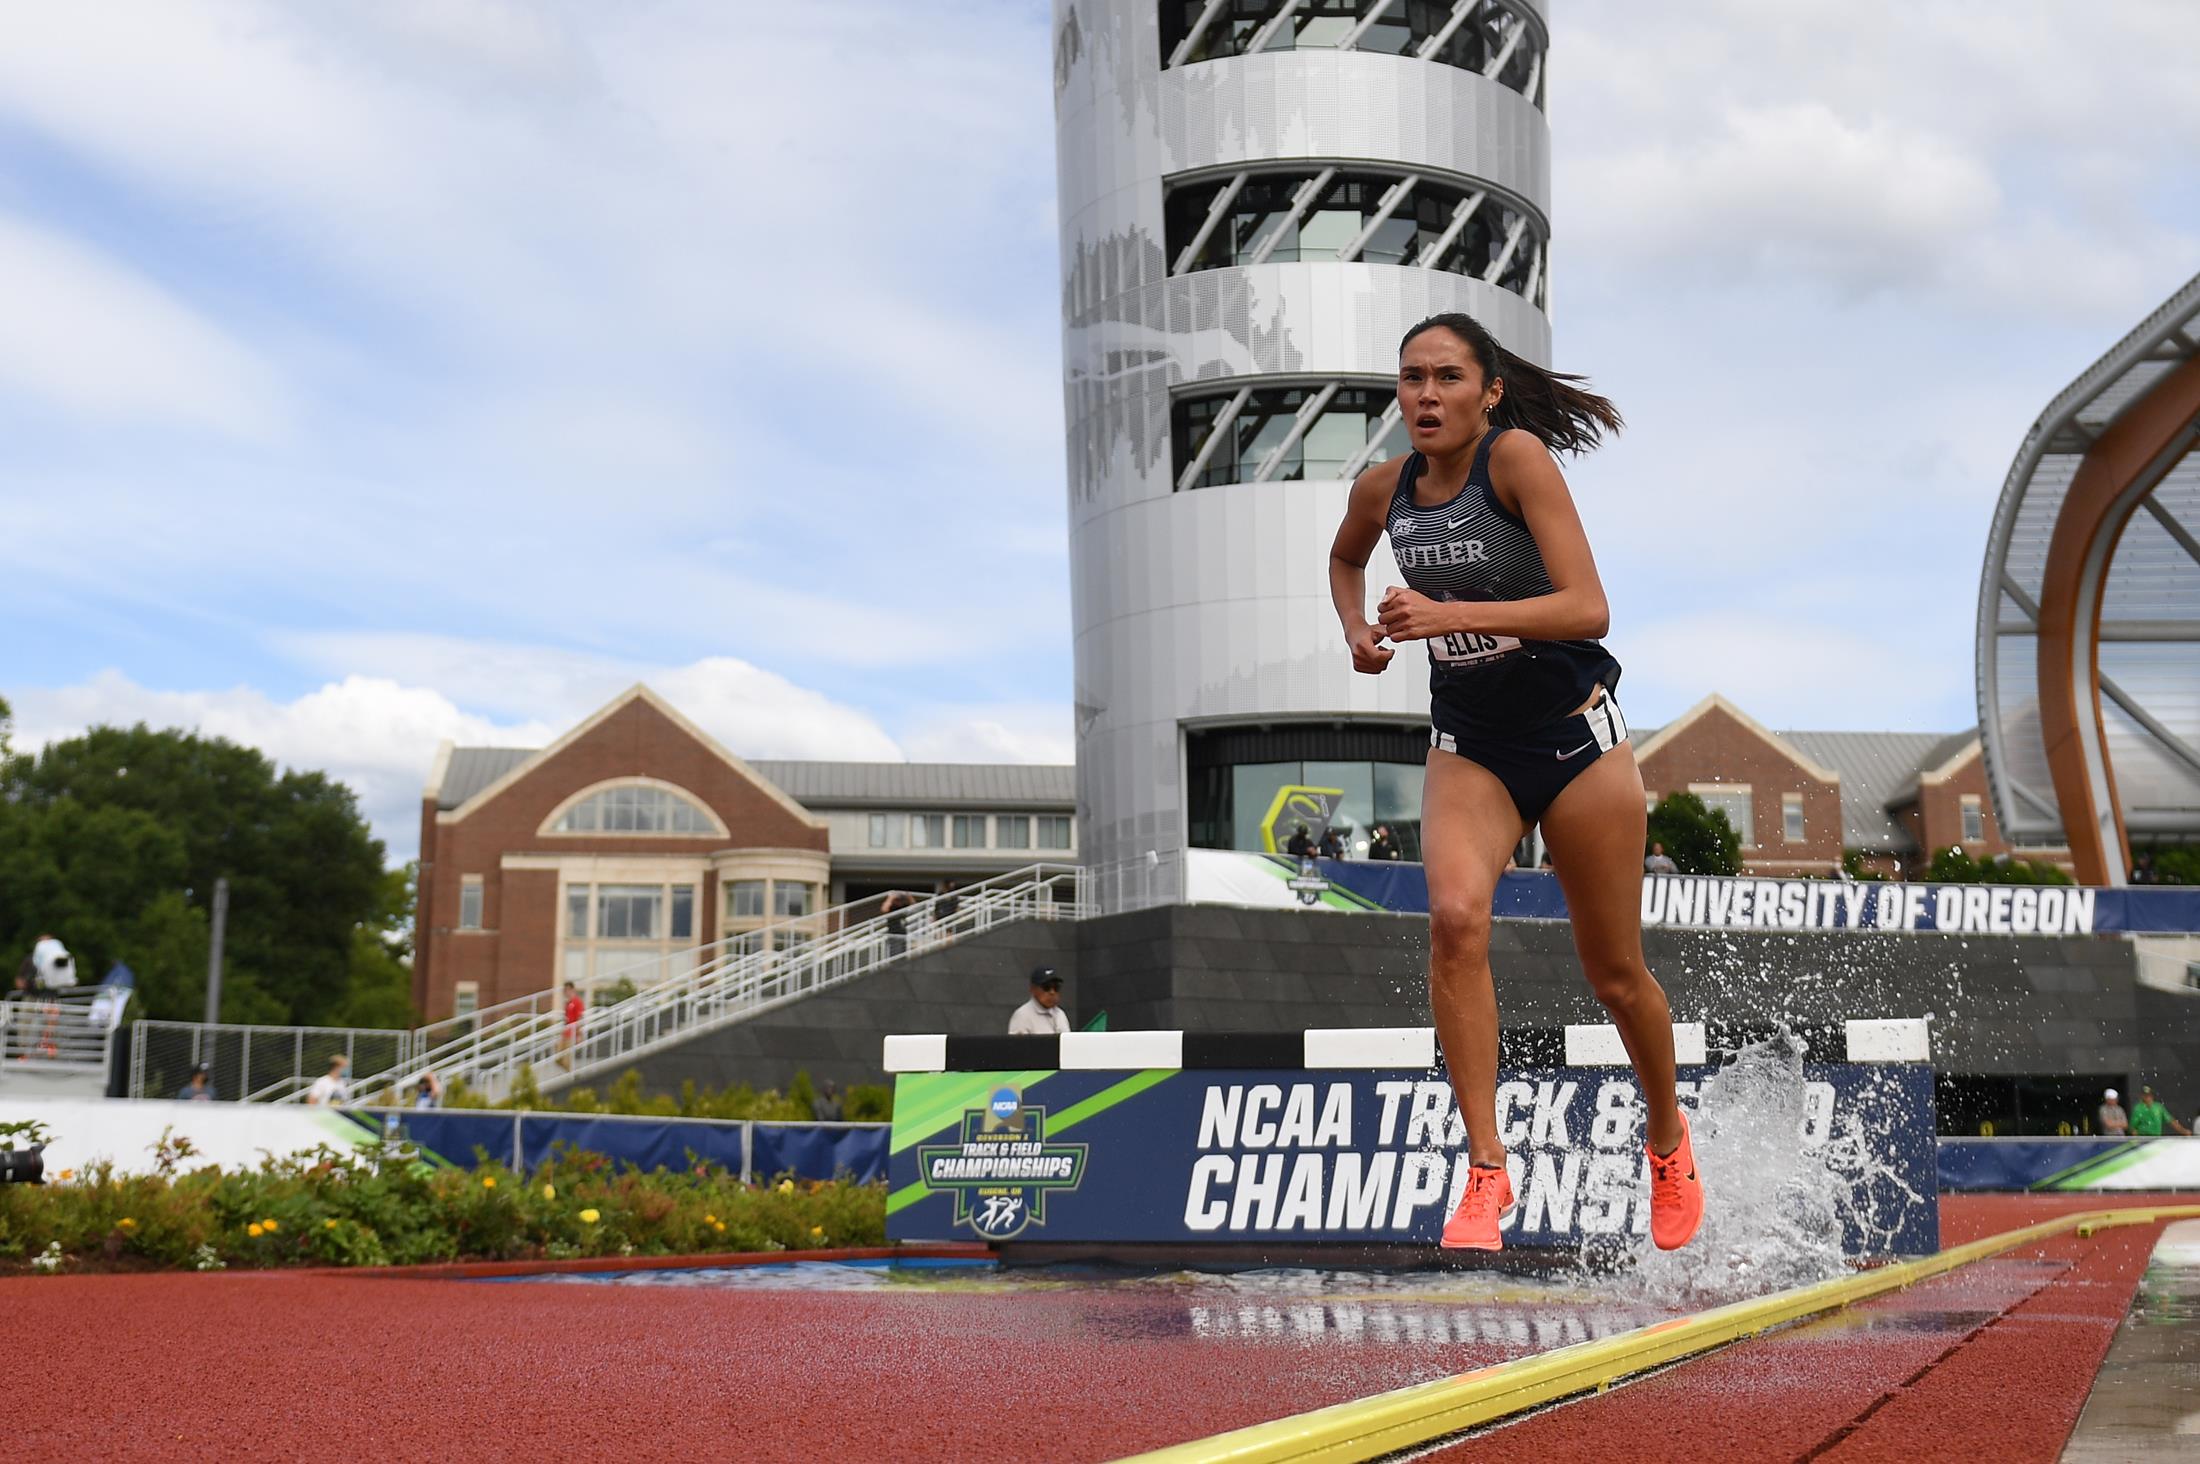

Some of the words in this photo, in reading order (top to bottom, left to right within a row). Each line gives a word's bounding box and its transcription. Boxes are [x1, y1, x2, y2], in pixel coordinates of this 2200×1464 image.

[1392, 540, 1489, 568] BUTLER
[1443, 632, 1498, 656] ELLIS
[1641, 876, 1868, 928] UNIVERSITY
[1876, 884, 1928, 932] OF
[1934, 885, 2096, 935] OREGON
[992, 1101, 1018, 1111] NCAA
[1197, 1082, 1353, 1148] NCAA
[1590, 1080, 1646, 1149] &
[963, 1143, 999, 1157] TRACK
[1000, 1143, 1009, 1156] &
[1009, 1142, 1043, 1156] FIELD
[931, 1157, 1073, 1180] CHAMPIONSHIPS
